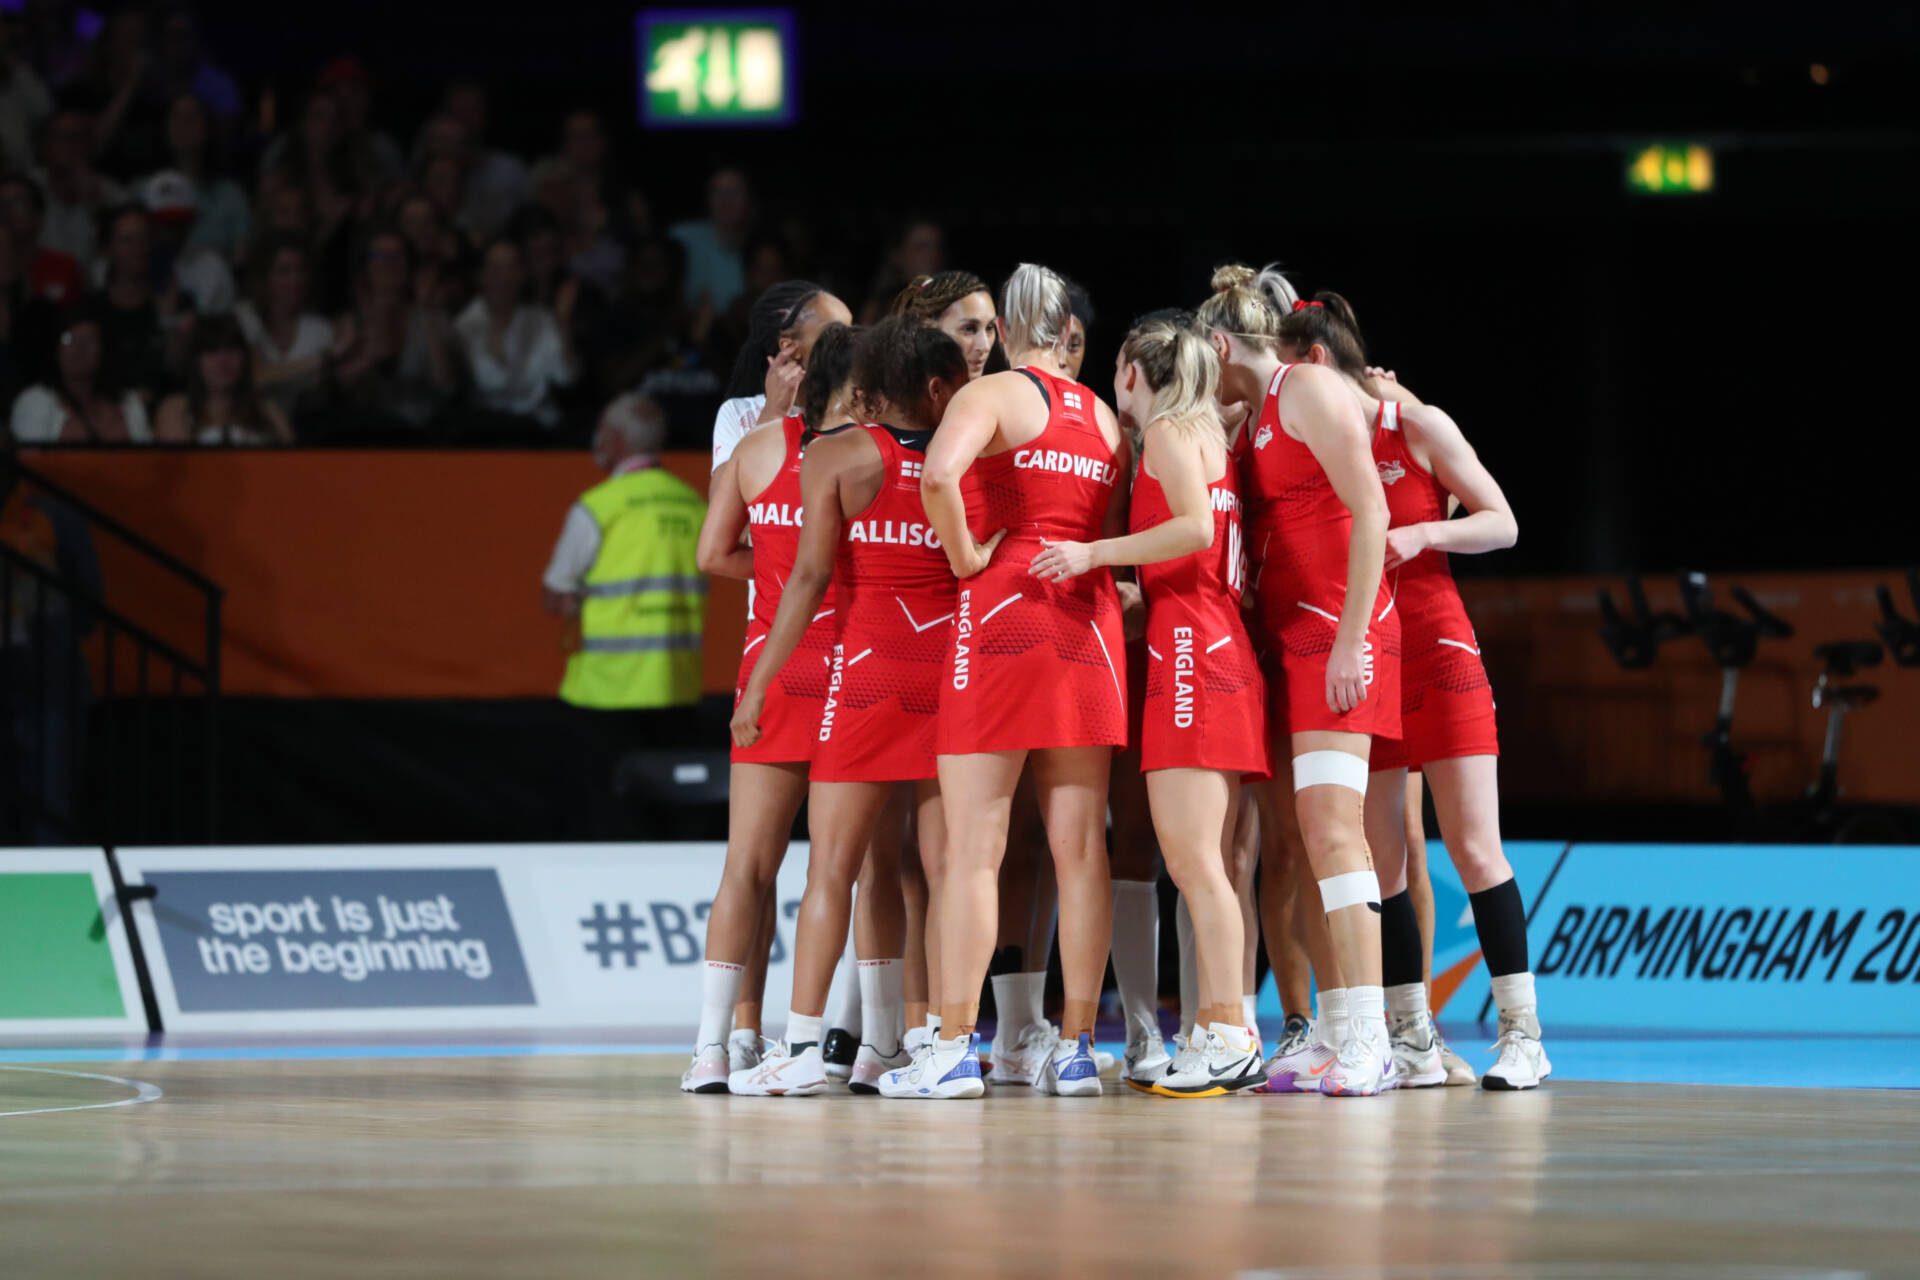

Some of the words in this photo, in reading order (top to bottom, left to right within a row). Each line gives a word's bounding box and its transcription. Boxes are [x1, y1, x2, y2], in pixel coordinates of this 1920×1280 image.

[953, 589, 971, 690] ENGLAND
[1173, 626, 1194, 728] ENGLAND
[818, 643, 844, 742] ENGLAND
[197, 936, 272, 974] the
[276, 933, 492, 982] beginning
[208, 895, 326, 939] sport
[331, 895, 373, 932] is
[377, 894, 461, 939] just
[1536, 904, 1867, 982] BIRMINGHAM
[1850, 907, 1920, 984] 20
